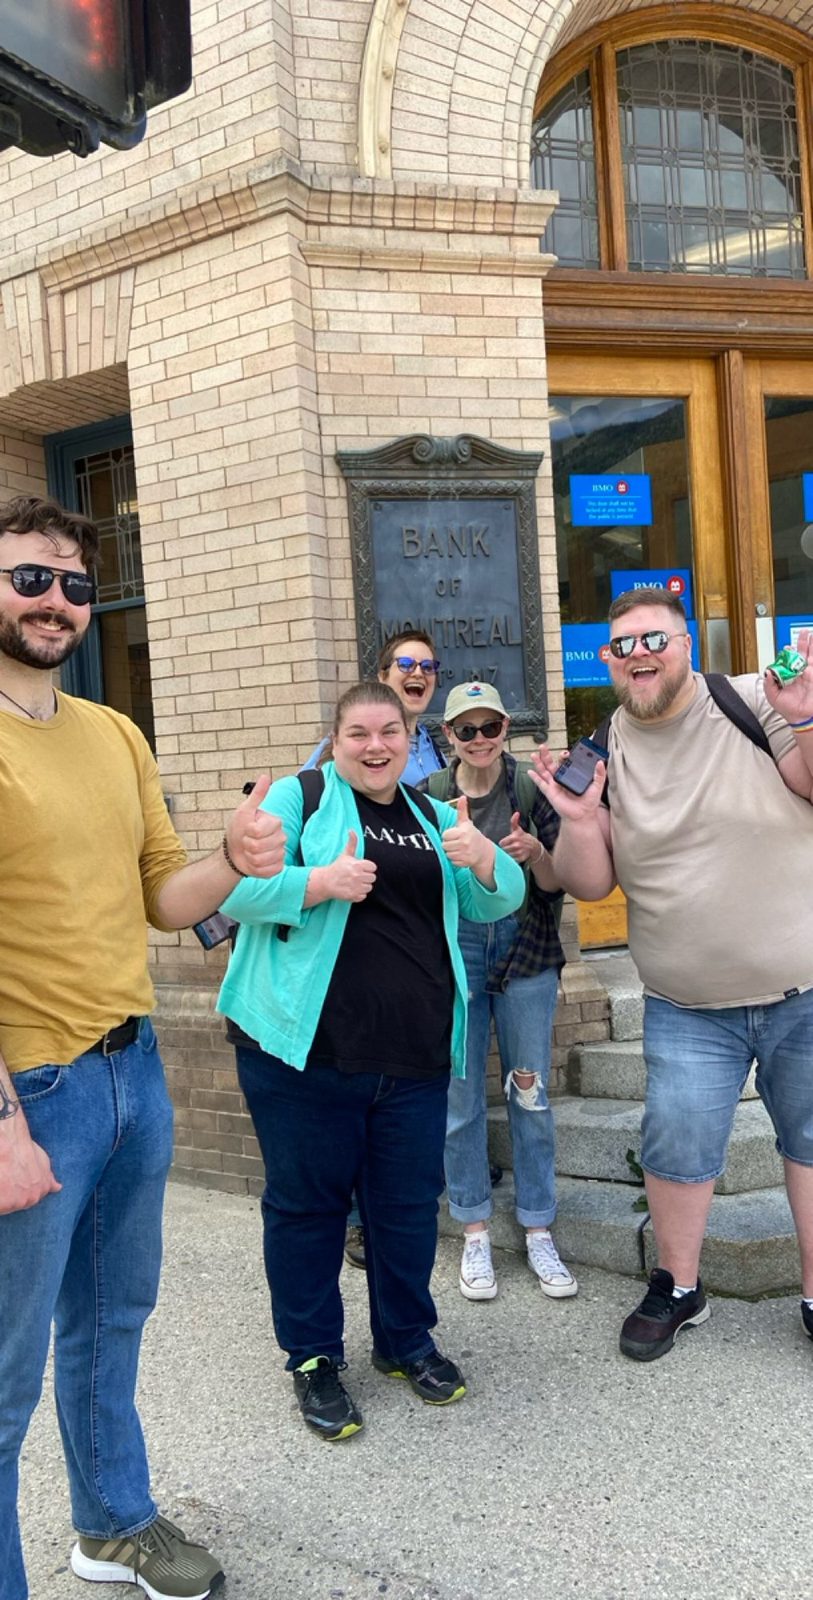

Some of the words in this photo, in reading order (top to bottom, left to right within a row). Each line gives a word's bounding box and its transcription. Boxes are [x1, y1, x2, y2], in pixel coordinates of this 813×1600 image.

[401, 526, 490, 558] BANK
[436, 577, 462, 597] OF
[566, 651, 595, 661] BMO
